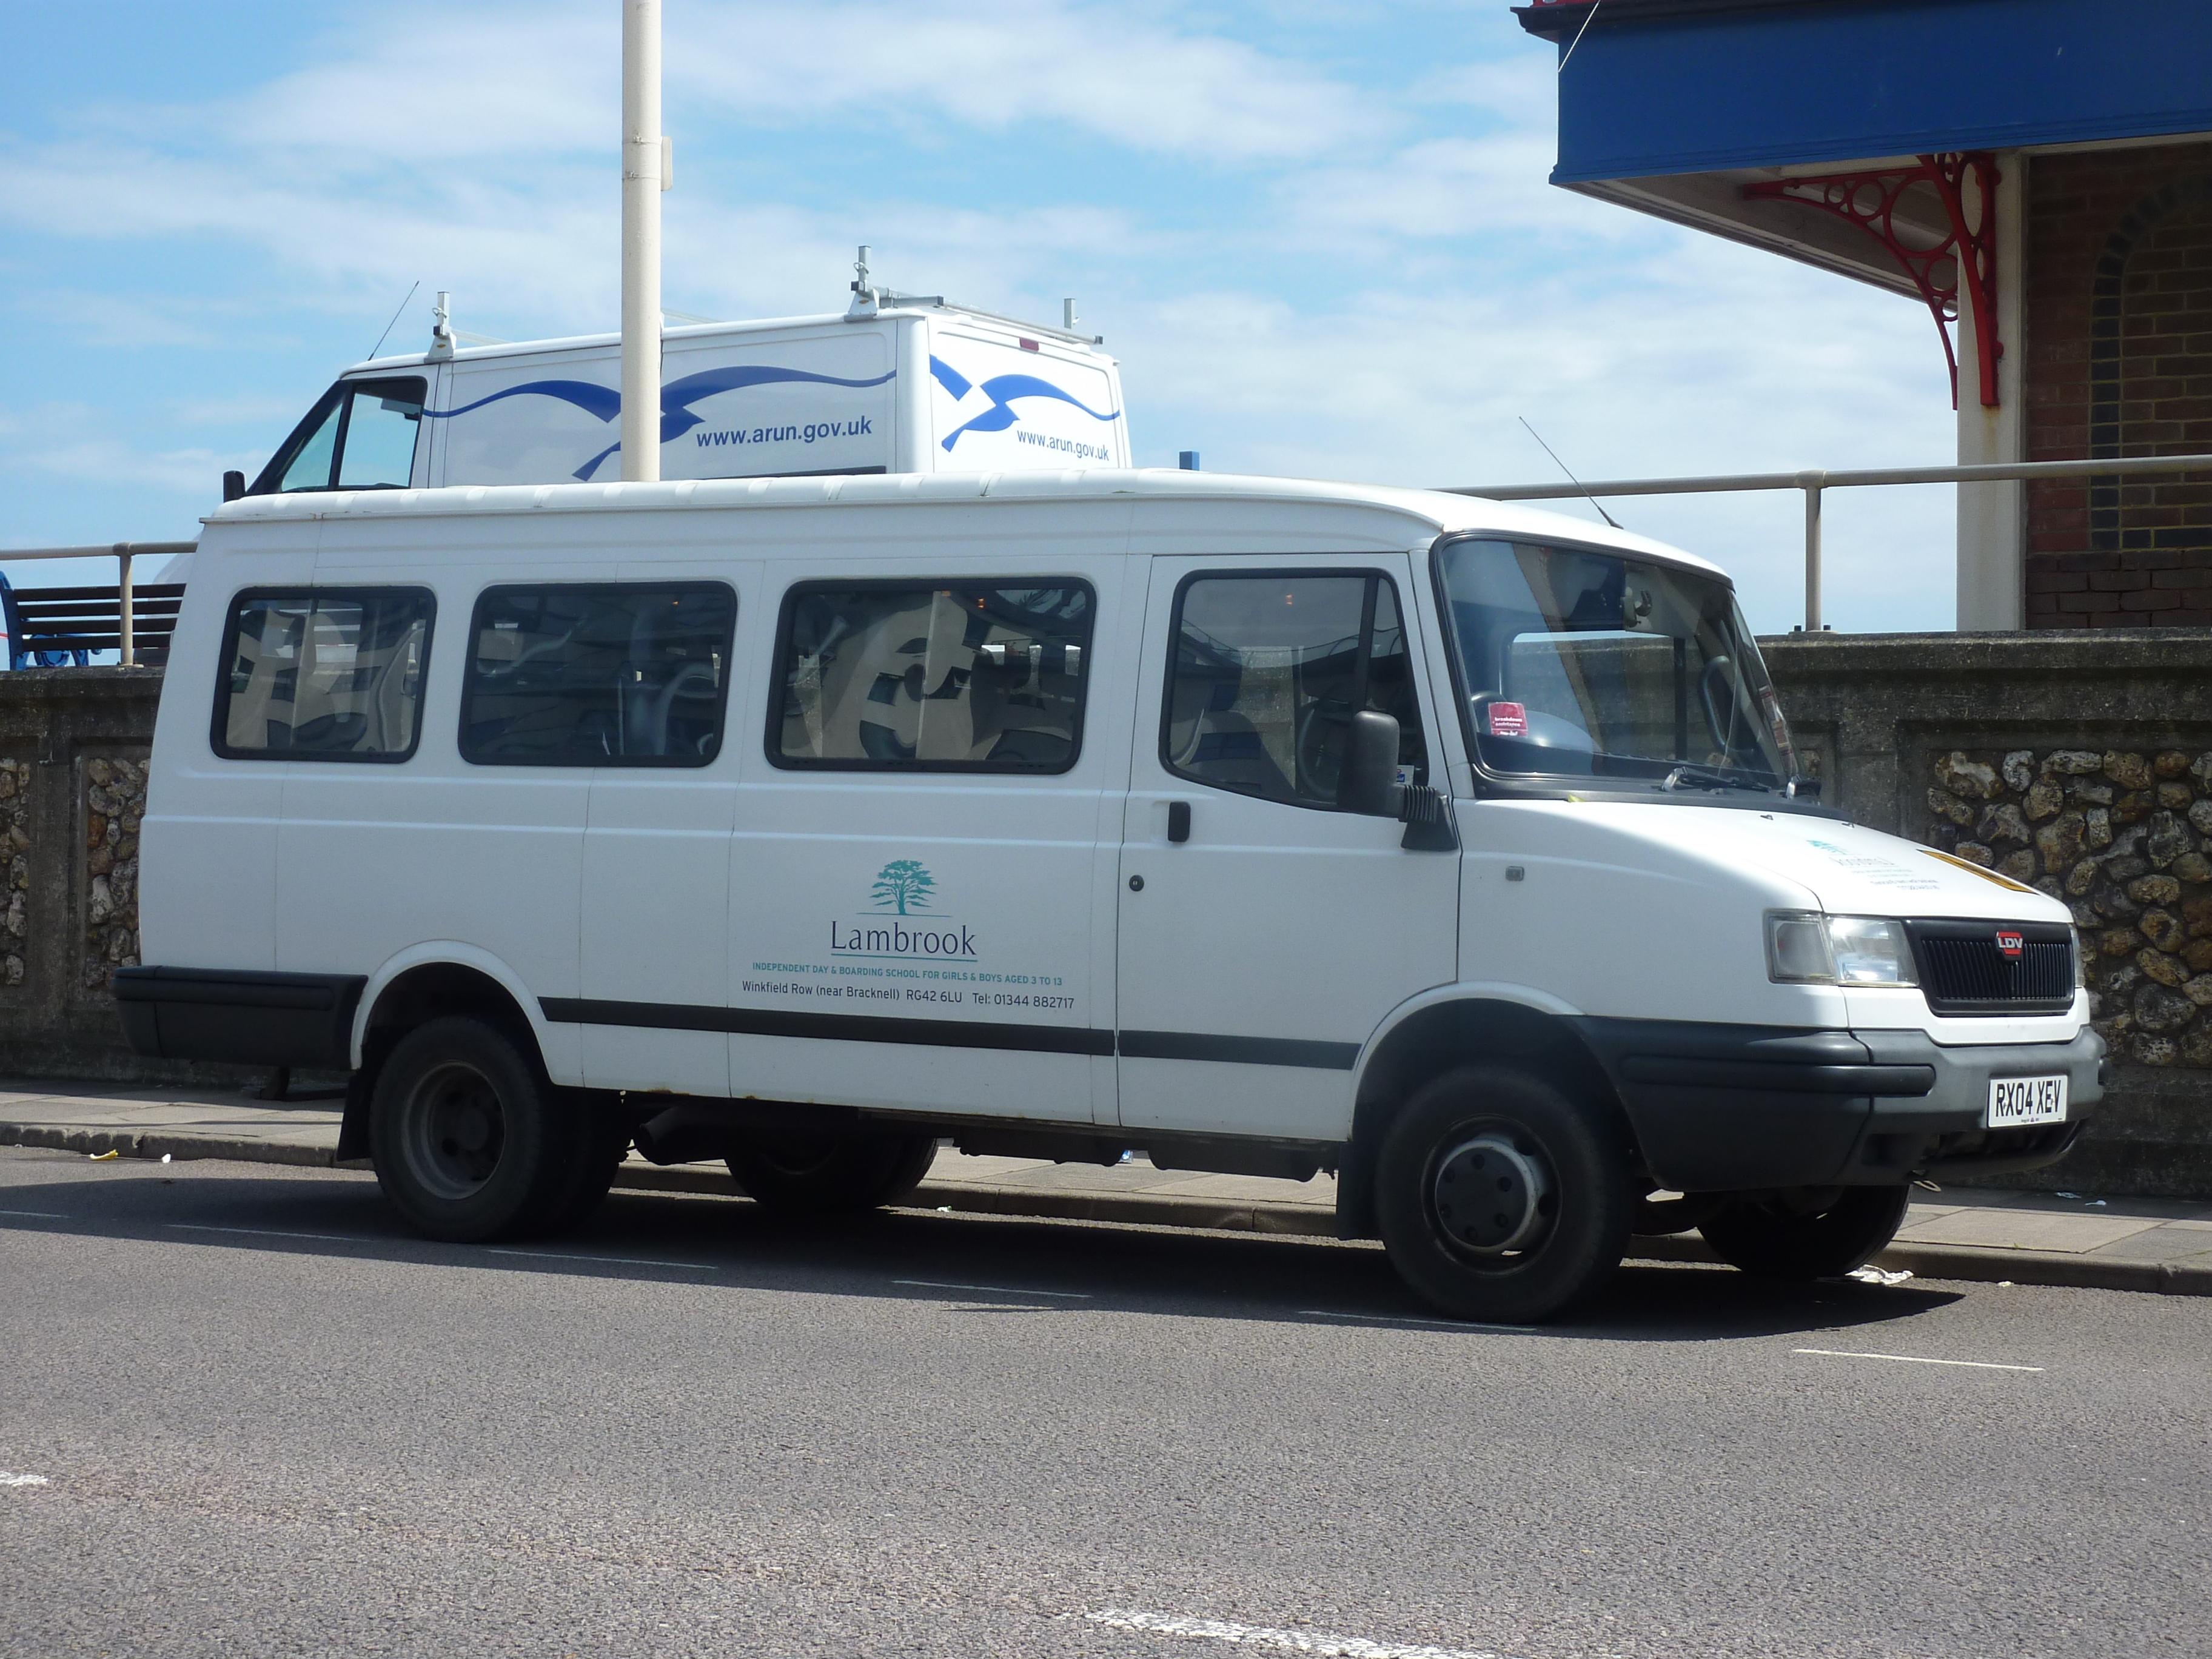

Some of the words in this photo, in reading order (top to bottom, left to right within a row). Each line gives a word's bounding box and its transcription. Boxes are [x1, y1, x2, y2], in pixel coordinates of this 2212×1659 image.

[697, 415, 873, 447] www.arun.gov.uk
[1017, 429, 1110, 461] www.arun.gov.uk
[831, 920, 977, 955] Lambrook
[1997, 937, 2023, 948] LDV
[752, 962, 810, 973] INDEPENDENT
[813, 965, 828, 974] DAY
[839, 967, 883, 976] BOARDING
[886, 969, 920, 978] SCHOOL
[922, 971, 939, 980] FOR
[942, 971, 968, 980] GIRLS
[970, 973, 976, 981] &
[979, 973, 1002, 982] BOYS
[1005, 975, 1028, 984] AGED
[1031, 976, 1037, 985] 3
[1039, 977, 1051, 985] TO
[1053, 977, 1062, 986] 13
[742, 980, 788, 994] Winkfield
[791, 983, 813, 995] Row
[816, 984, 842, 996] (near
[846, 986, 900, 1000] Bracknell)
[907, 989, 937, 1002] RG42
[940, 991, 962, 1003] 6LU
[973, 992, 990, 1005] Tel:
[994, 993, 1029, 1007] 01344
[1033, 996, 1074, 1009] 882717
[1996, 1082, 2033, 1117] RX04
[2036, 1079, 2062, 1114] XEV
